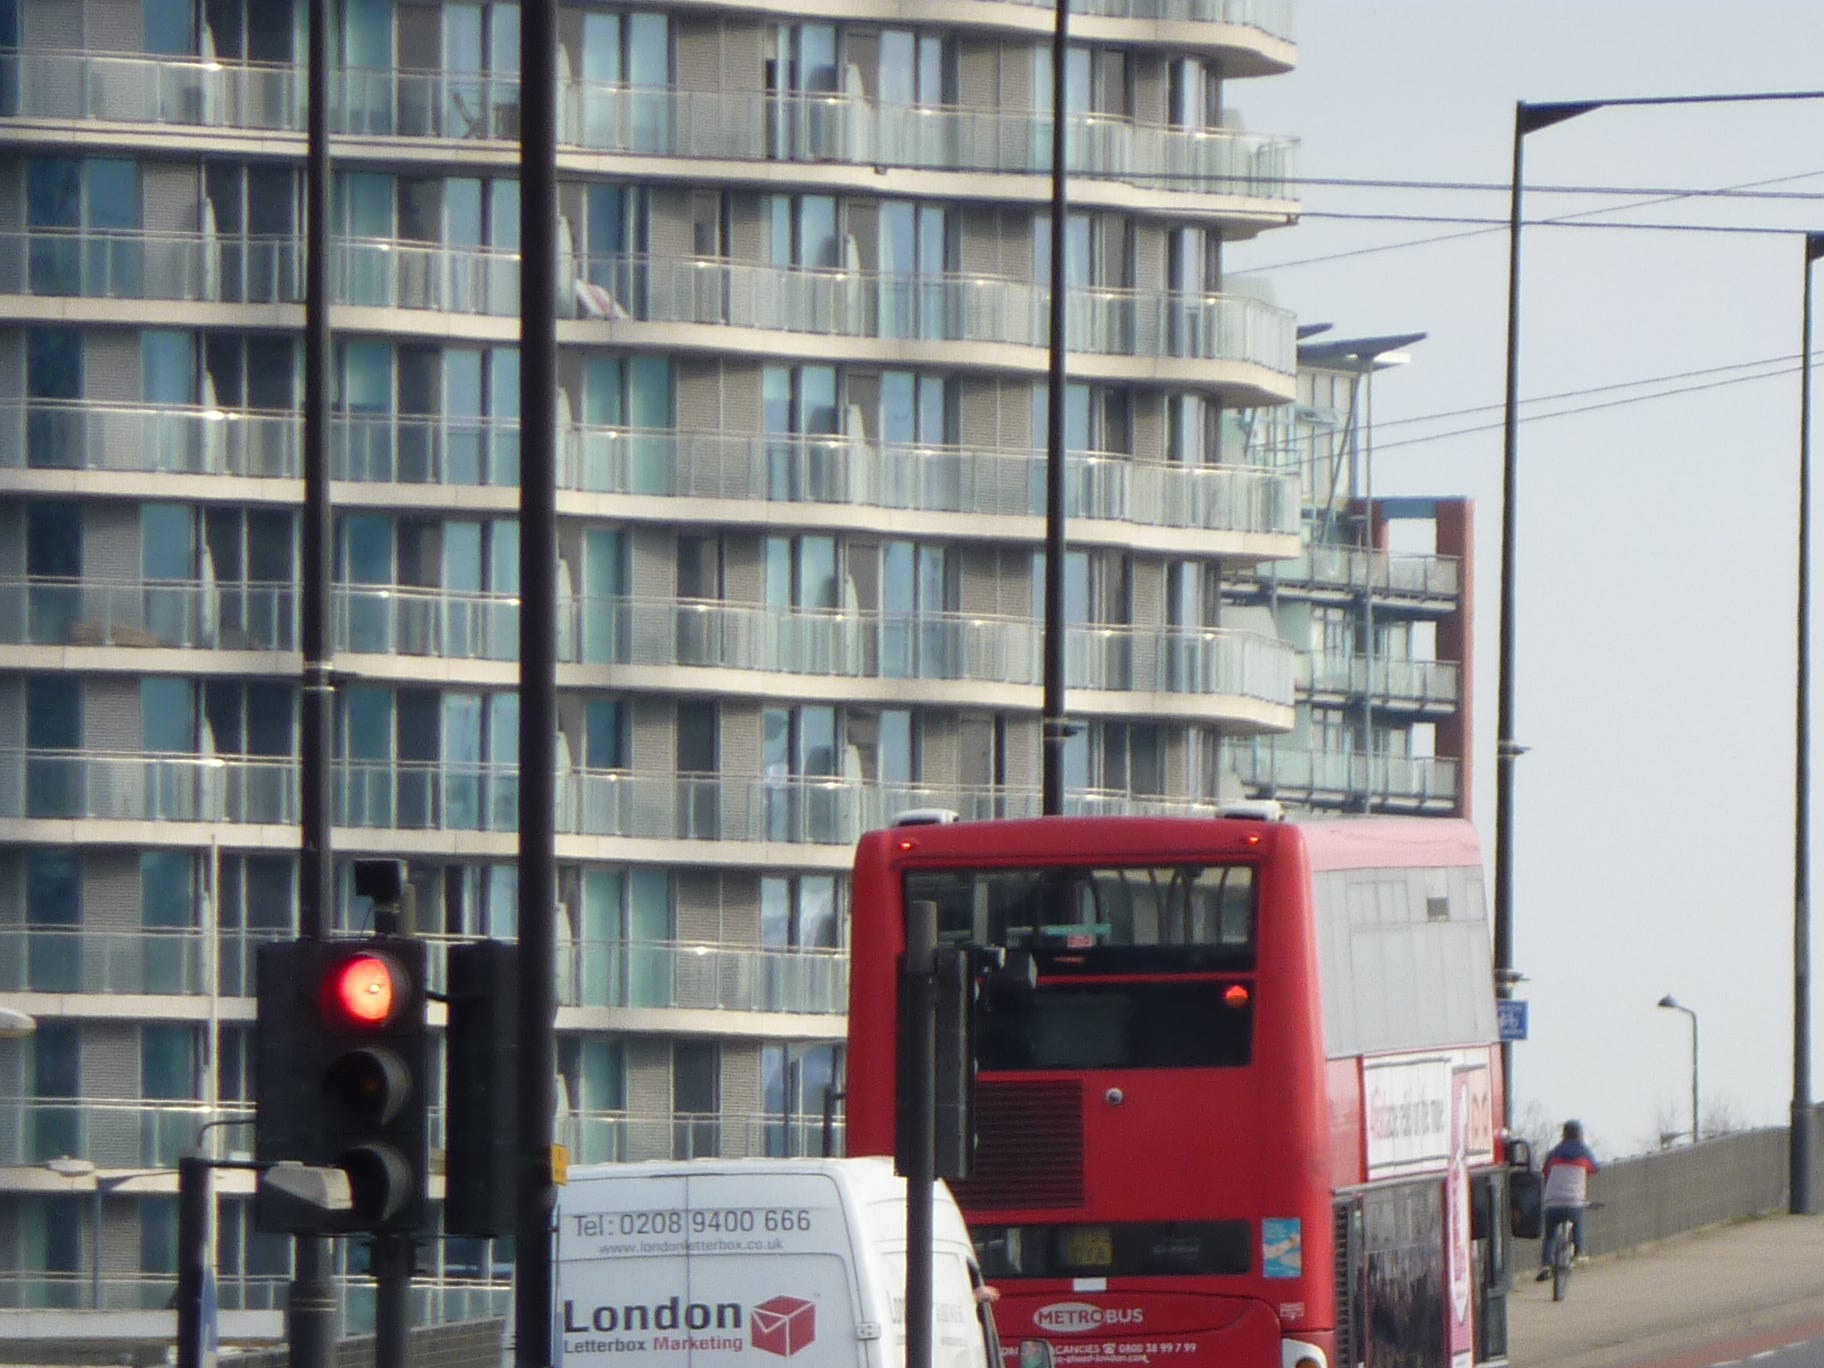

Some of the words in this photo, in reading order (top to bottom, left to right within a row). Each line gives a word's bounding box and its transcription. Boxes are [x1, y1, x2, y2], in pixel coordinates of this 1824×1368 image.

[573, 1214, 614, 1237] Tel:
[620, 1212, 682, 1235] 0208
[692, 1210, 754, 1233] 9400
[764, 1210, 812, 1232] 666
[600, 1238, 783, 1254] www.londonletterbox.co.uk
[564, 1296, 743, 1334] London
[1038, 1308, 1144, 1325] METROBUS
[564, 1338, 647, 1354] Letterbox
[653, 1336, 743, 1352] Marketing
